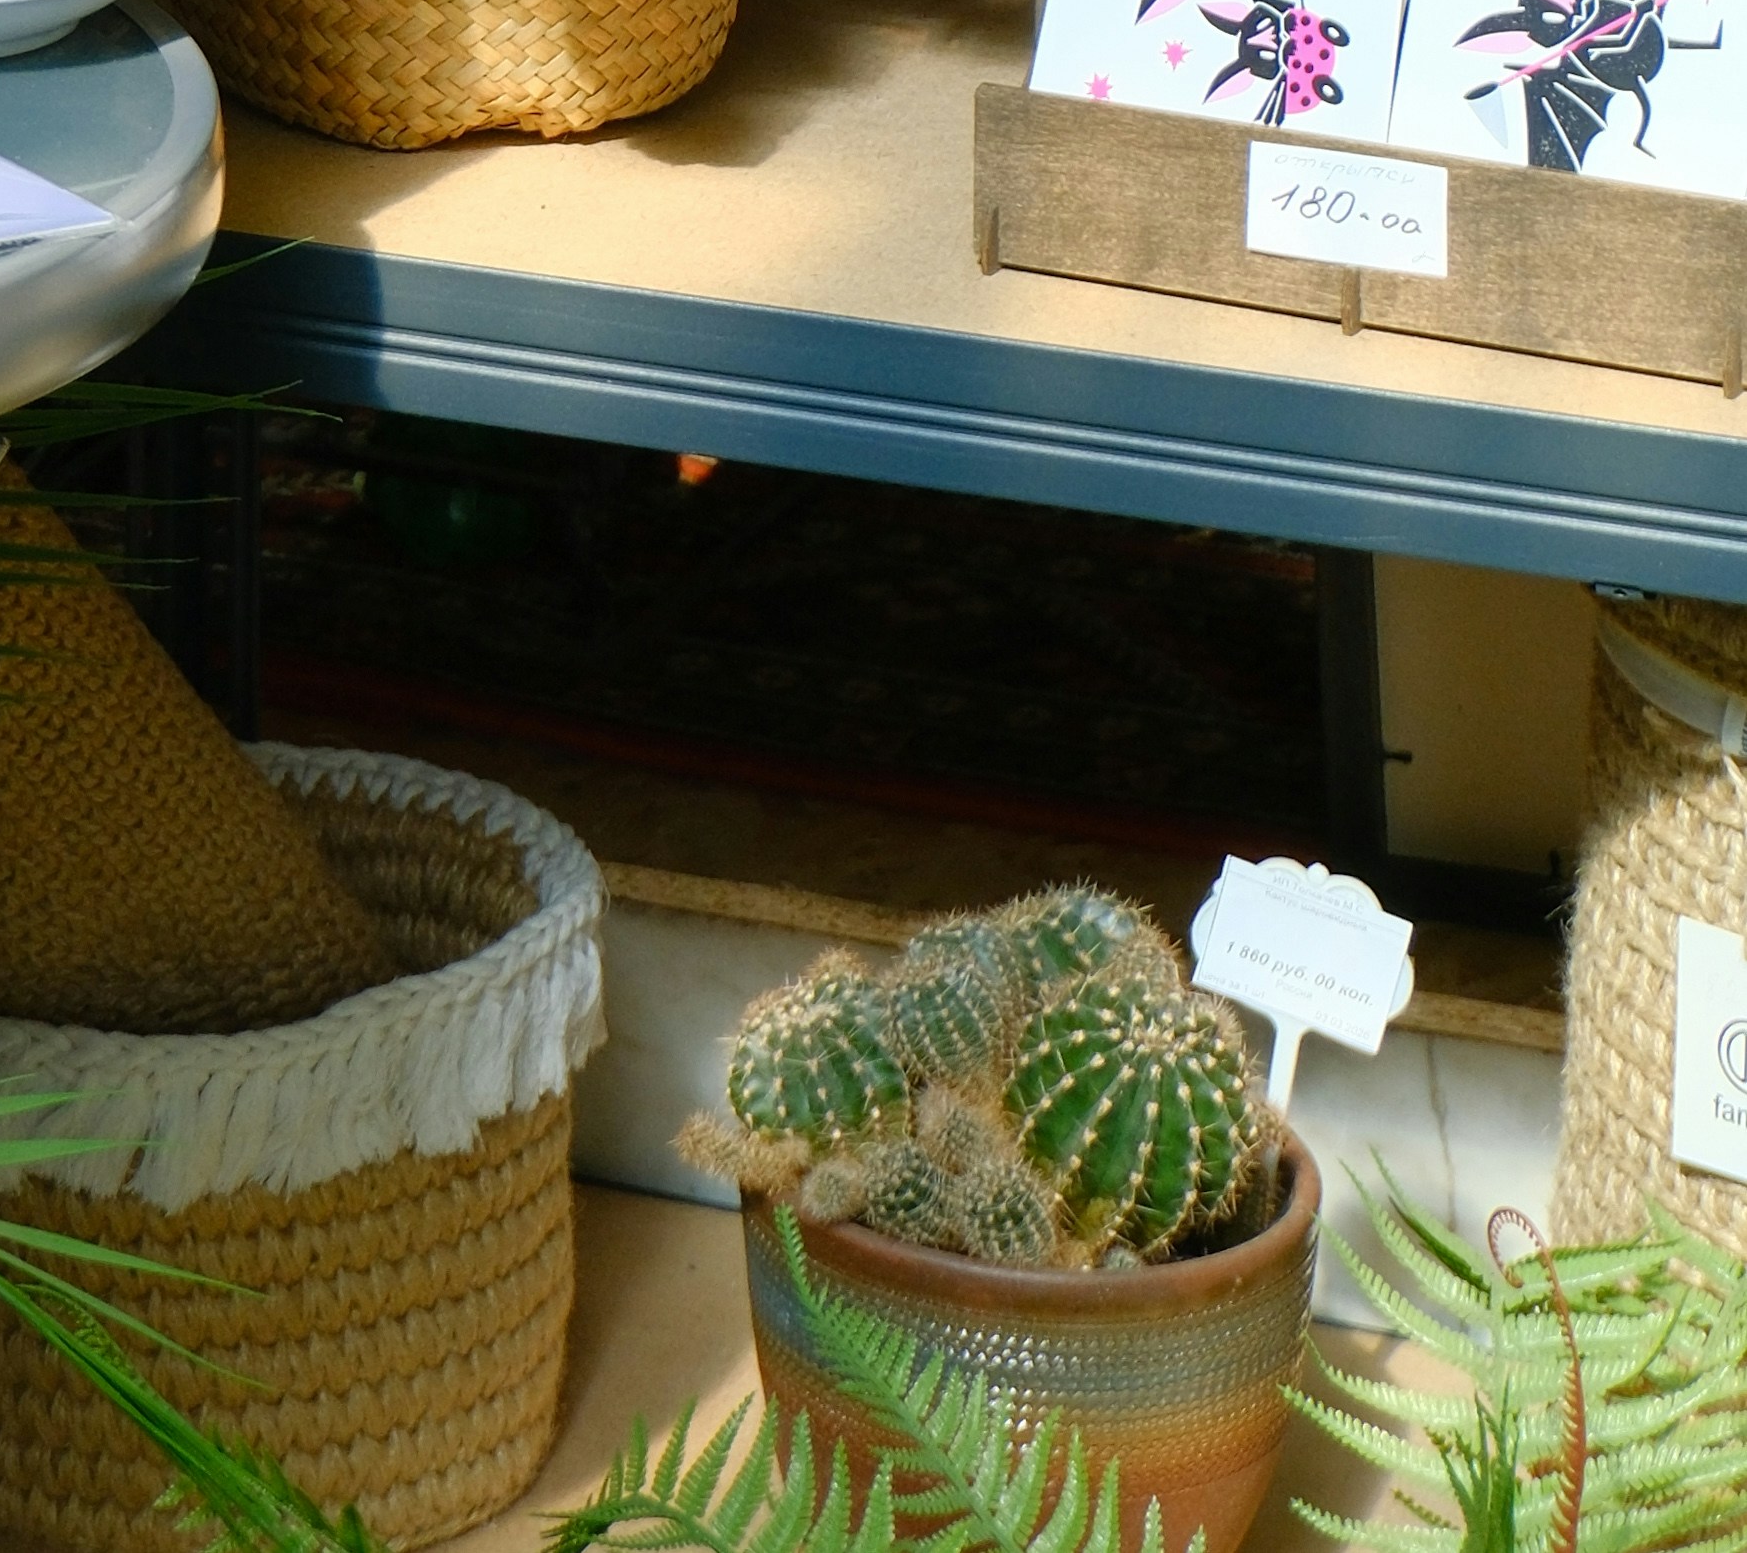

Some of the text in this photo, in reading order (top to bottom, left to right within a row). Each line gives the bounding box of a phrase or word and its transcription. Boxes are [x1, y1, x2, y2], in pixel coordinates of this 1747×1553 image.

[1227, 940, 1374, 1007] 1 860 руб. 00 коп.
